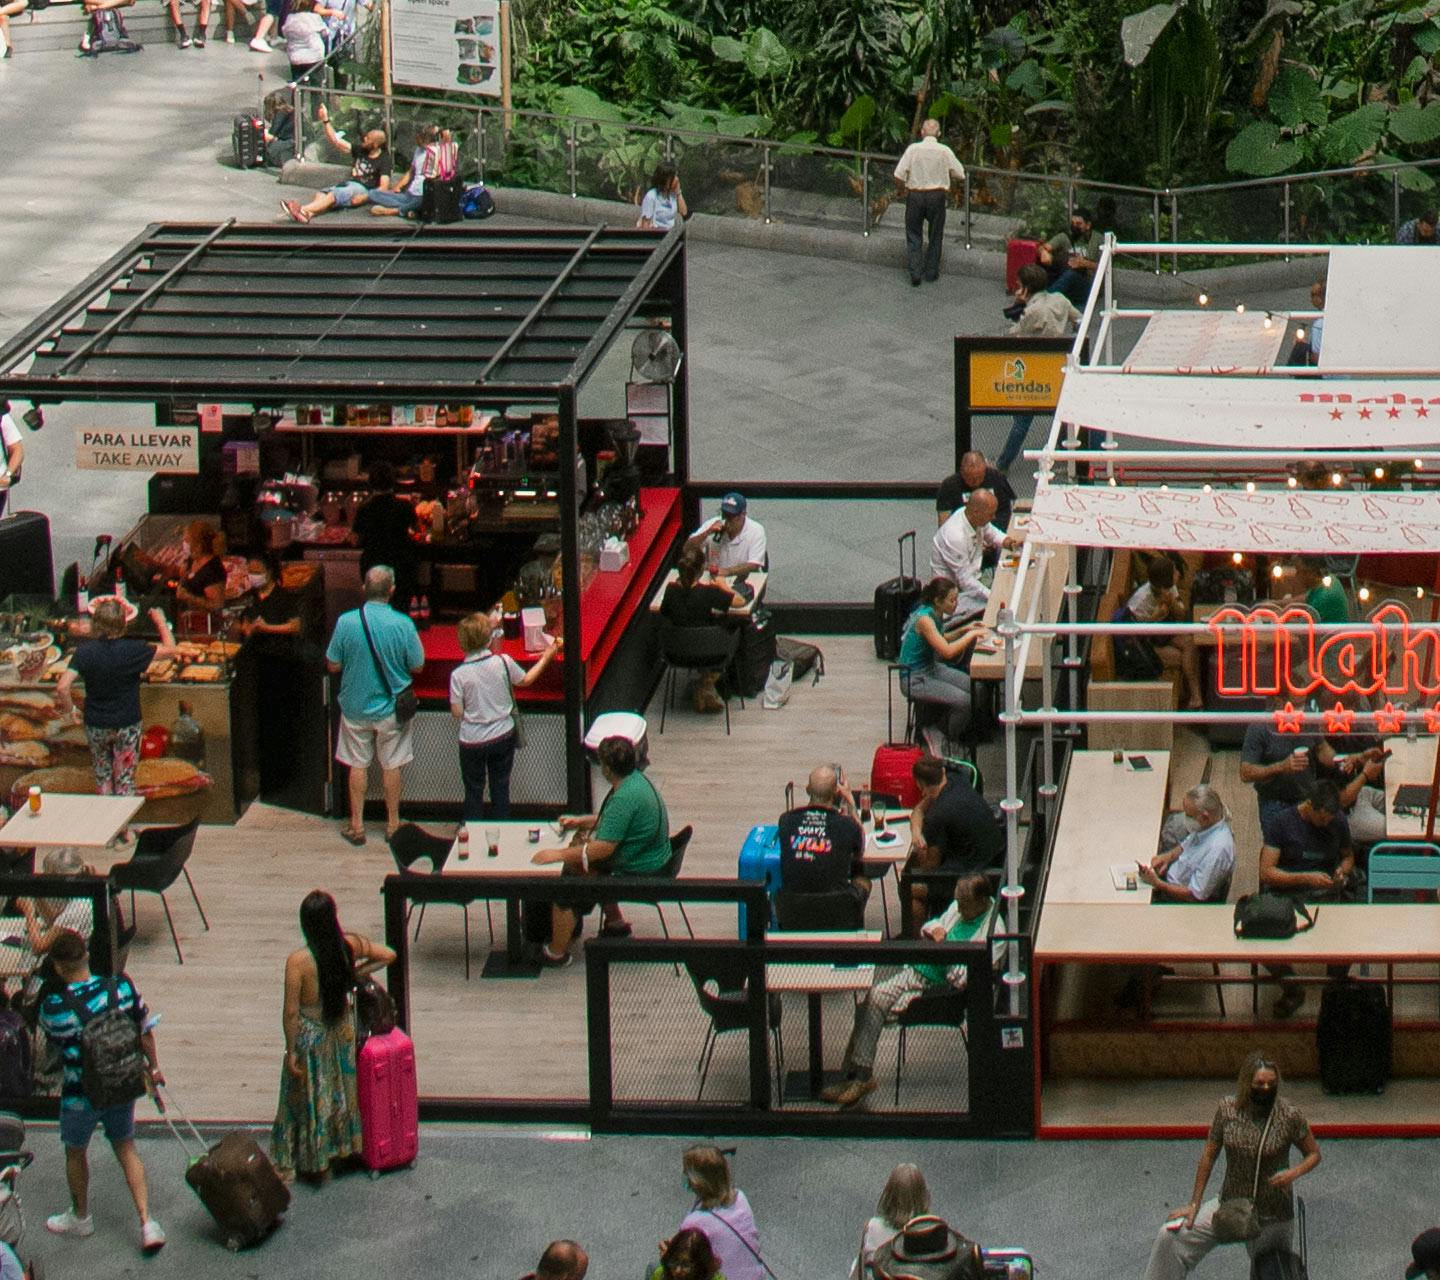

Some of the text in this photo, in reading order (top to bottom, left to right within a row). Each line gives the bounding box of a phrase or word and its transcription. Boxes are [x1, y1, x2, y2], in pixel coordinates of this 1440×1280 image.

[994, 380, 1051, 393] tiendas
[83, 432, 192, 447] PARA LLEVAR
[93, 451, 183, 467] TAKE AWAY
